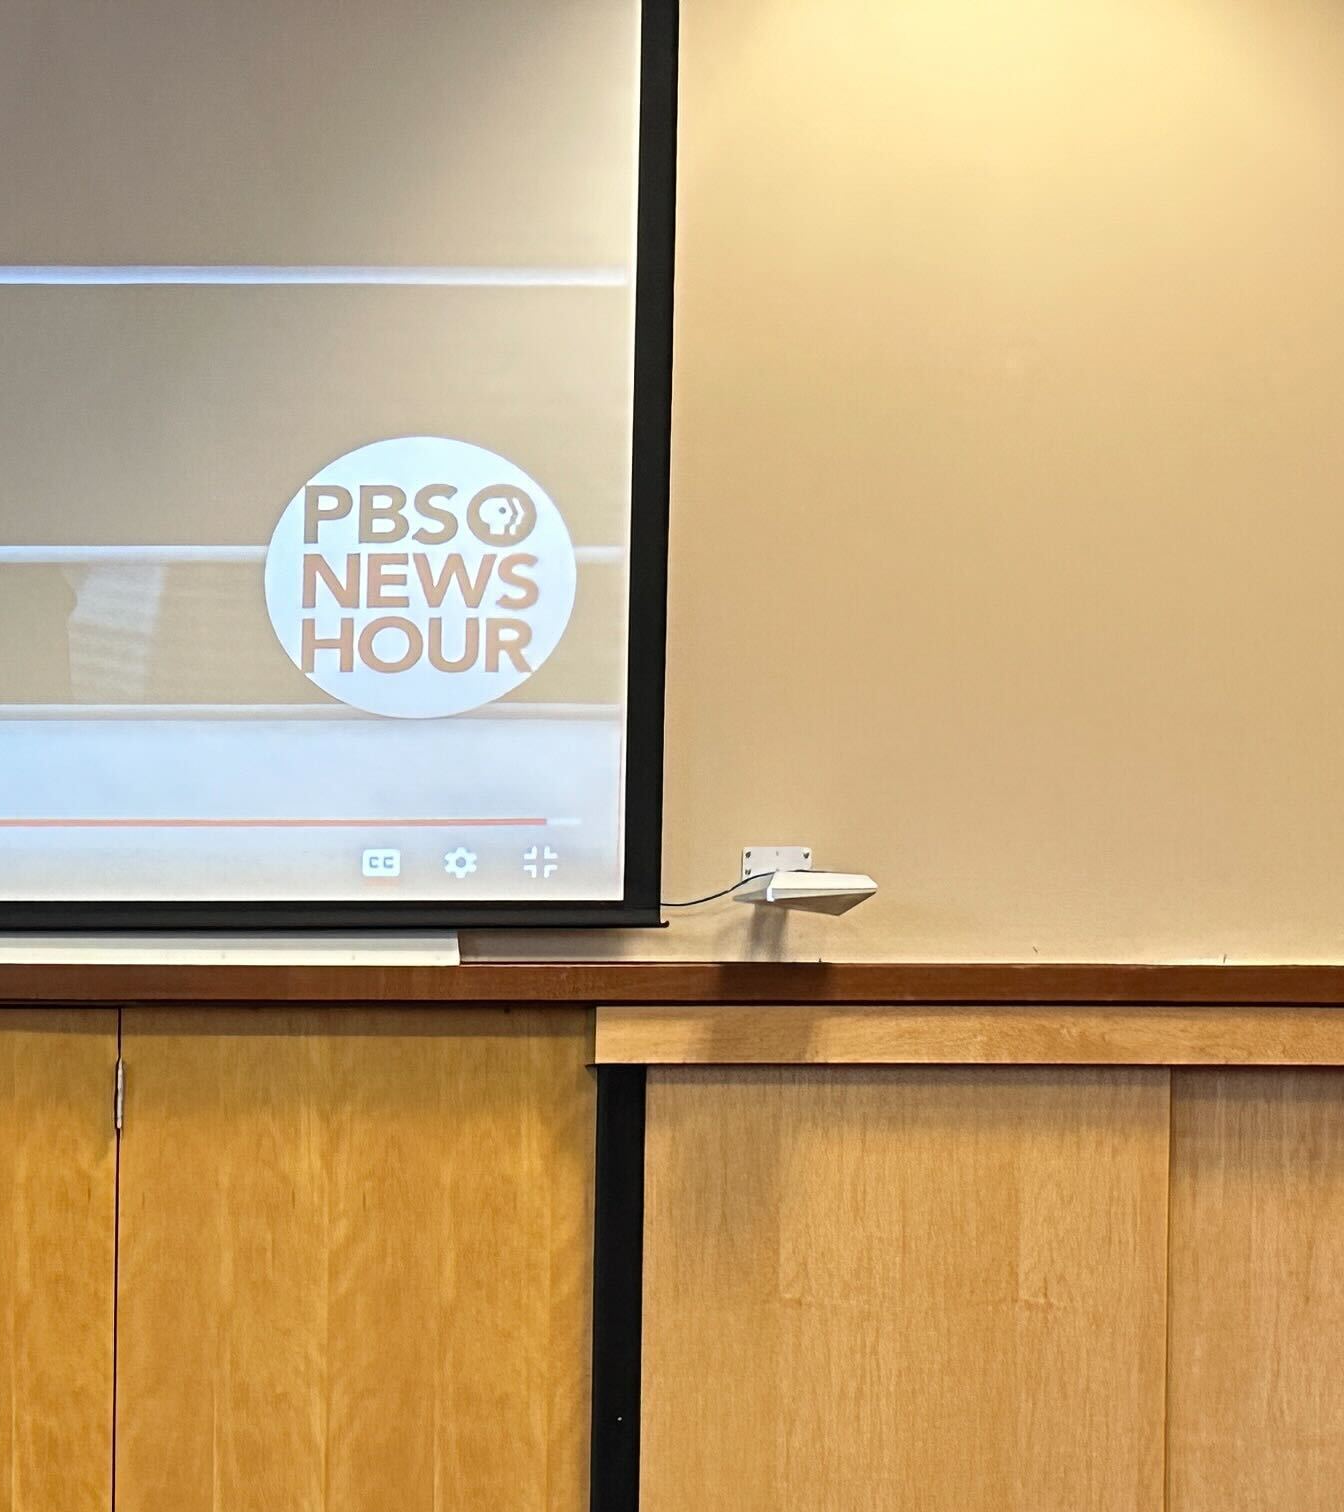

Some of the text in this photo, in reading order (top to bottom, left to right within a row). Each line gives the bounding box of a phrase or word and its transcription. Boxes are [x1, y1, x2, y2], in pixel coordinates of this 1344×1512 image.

[303, 483, 458, 545] PBS
[301, 553, 540, 610] NEWS
[300, 616, 536, 674] HOUR
